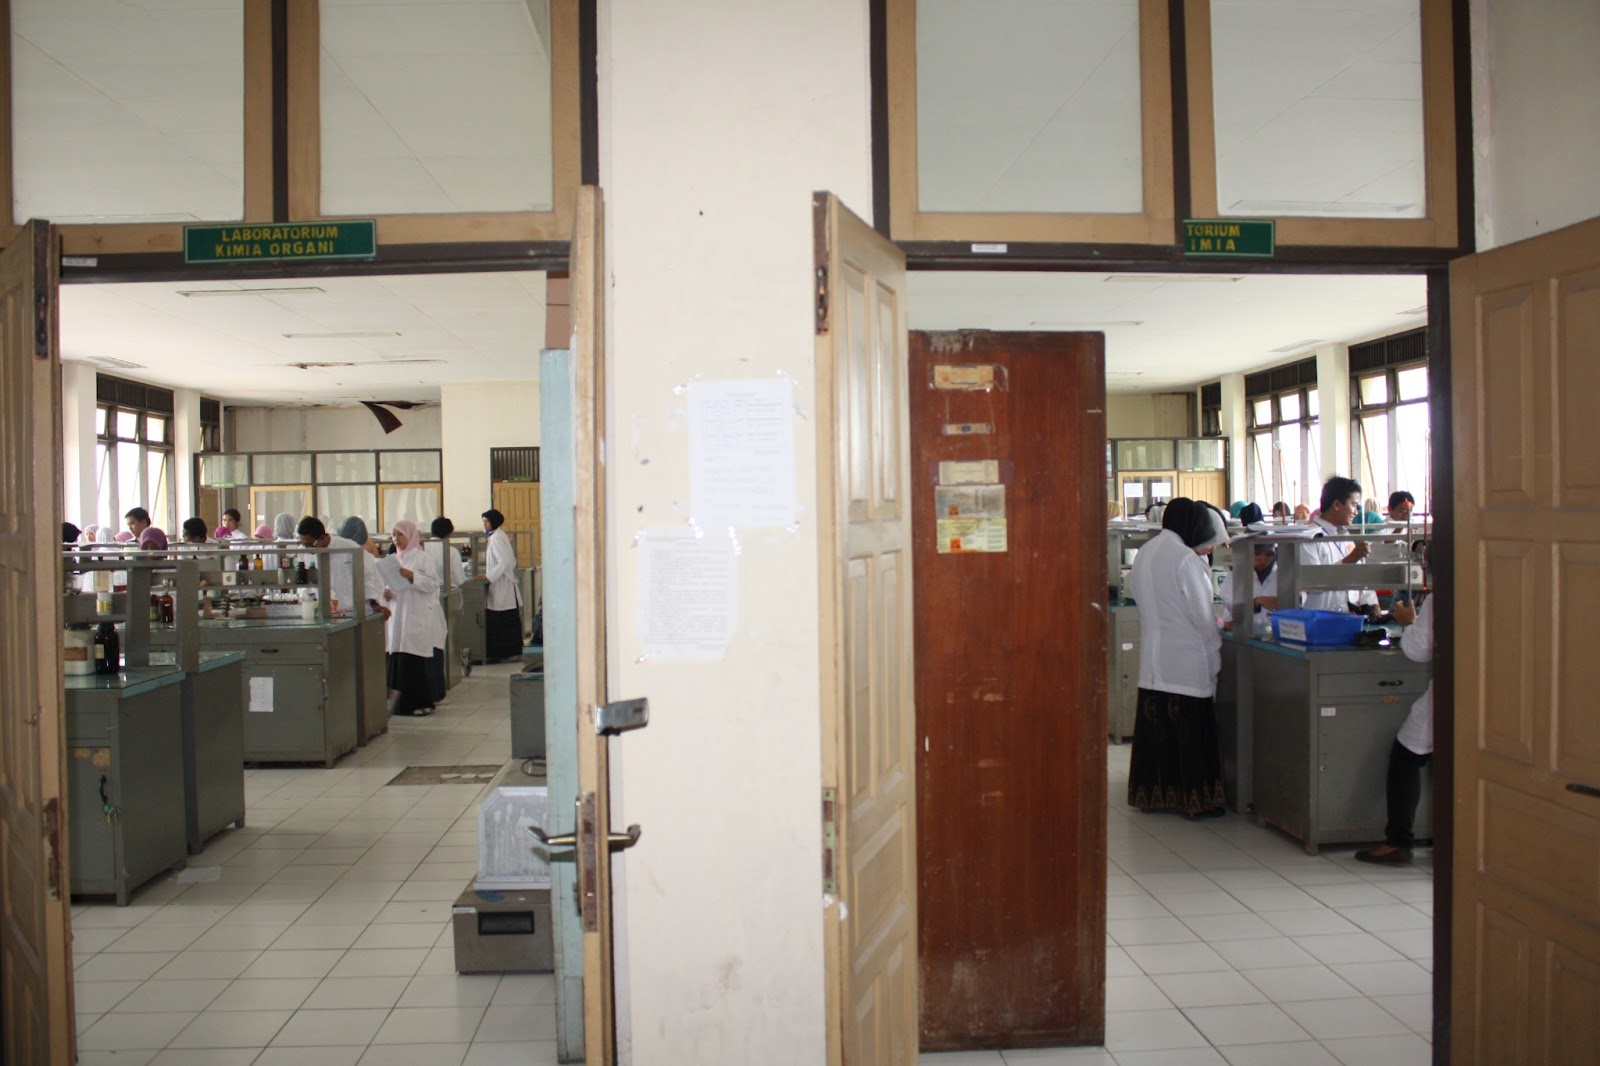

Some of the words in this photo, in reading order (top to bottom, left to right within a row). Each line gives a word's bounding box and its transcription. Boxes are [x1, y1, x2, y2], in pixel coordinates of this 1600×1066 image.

[221, 226, 338, 242] LABORATORIUM
[1186, 224, 1240, 236] TORIUM
[215, 244, 263, 257] KIMIA
[269, 241, 334, 256] ORGANI
